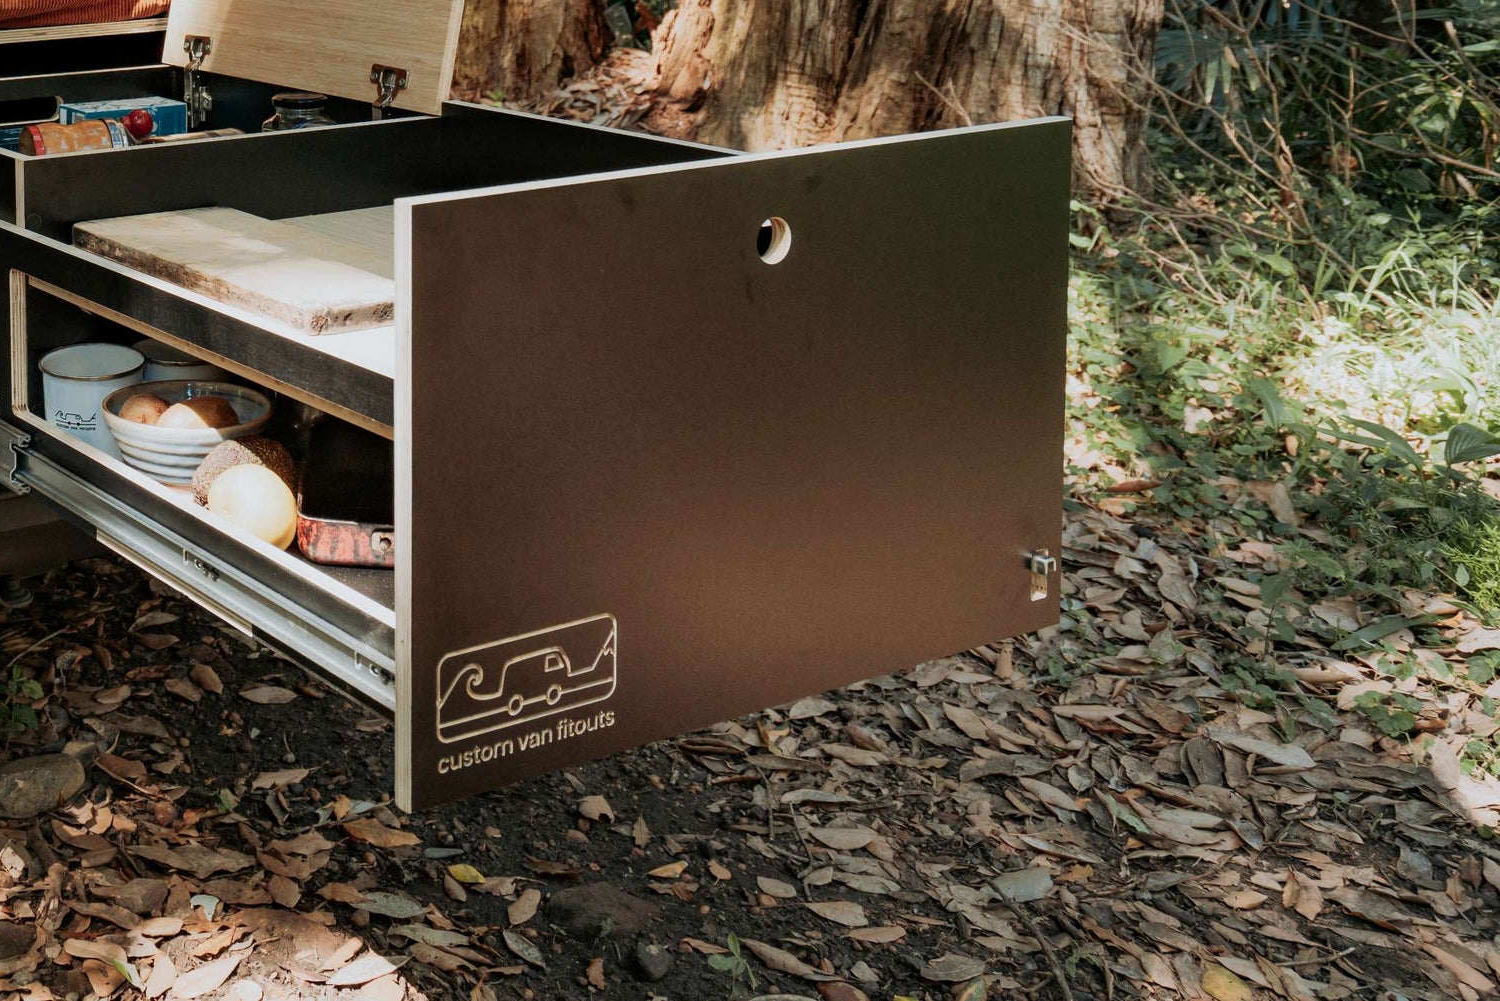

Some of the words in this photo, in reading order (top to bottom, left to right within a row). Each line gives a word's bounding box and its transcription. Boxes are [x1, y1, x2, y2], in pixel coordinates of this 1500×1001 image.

[437, 740, 514, 774] custom
[517, 728, 553, 751] van
[556, 710, 615, 741] fitouts
